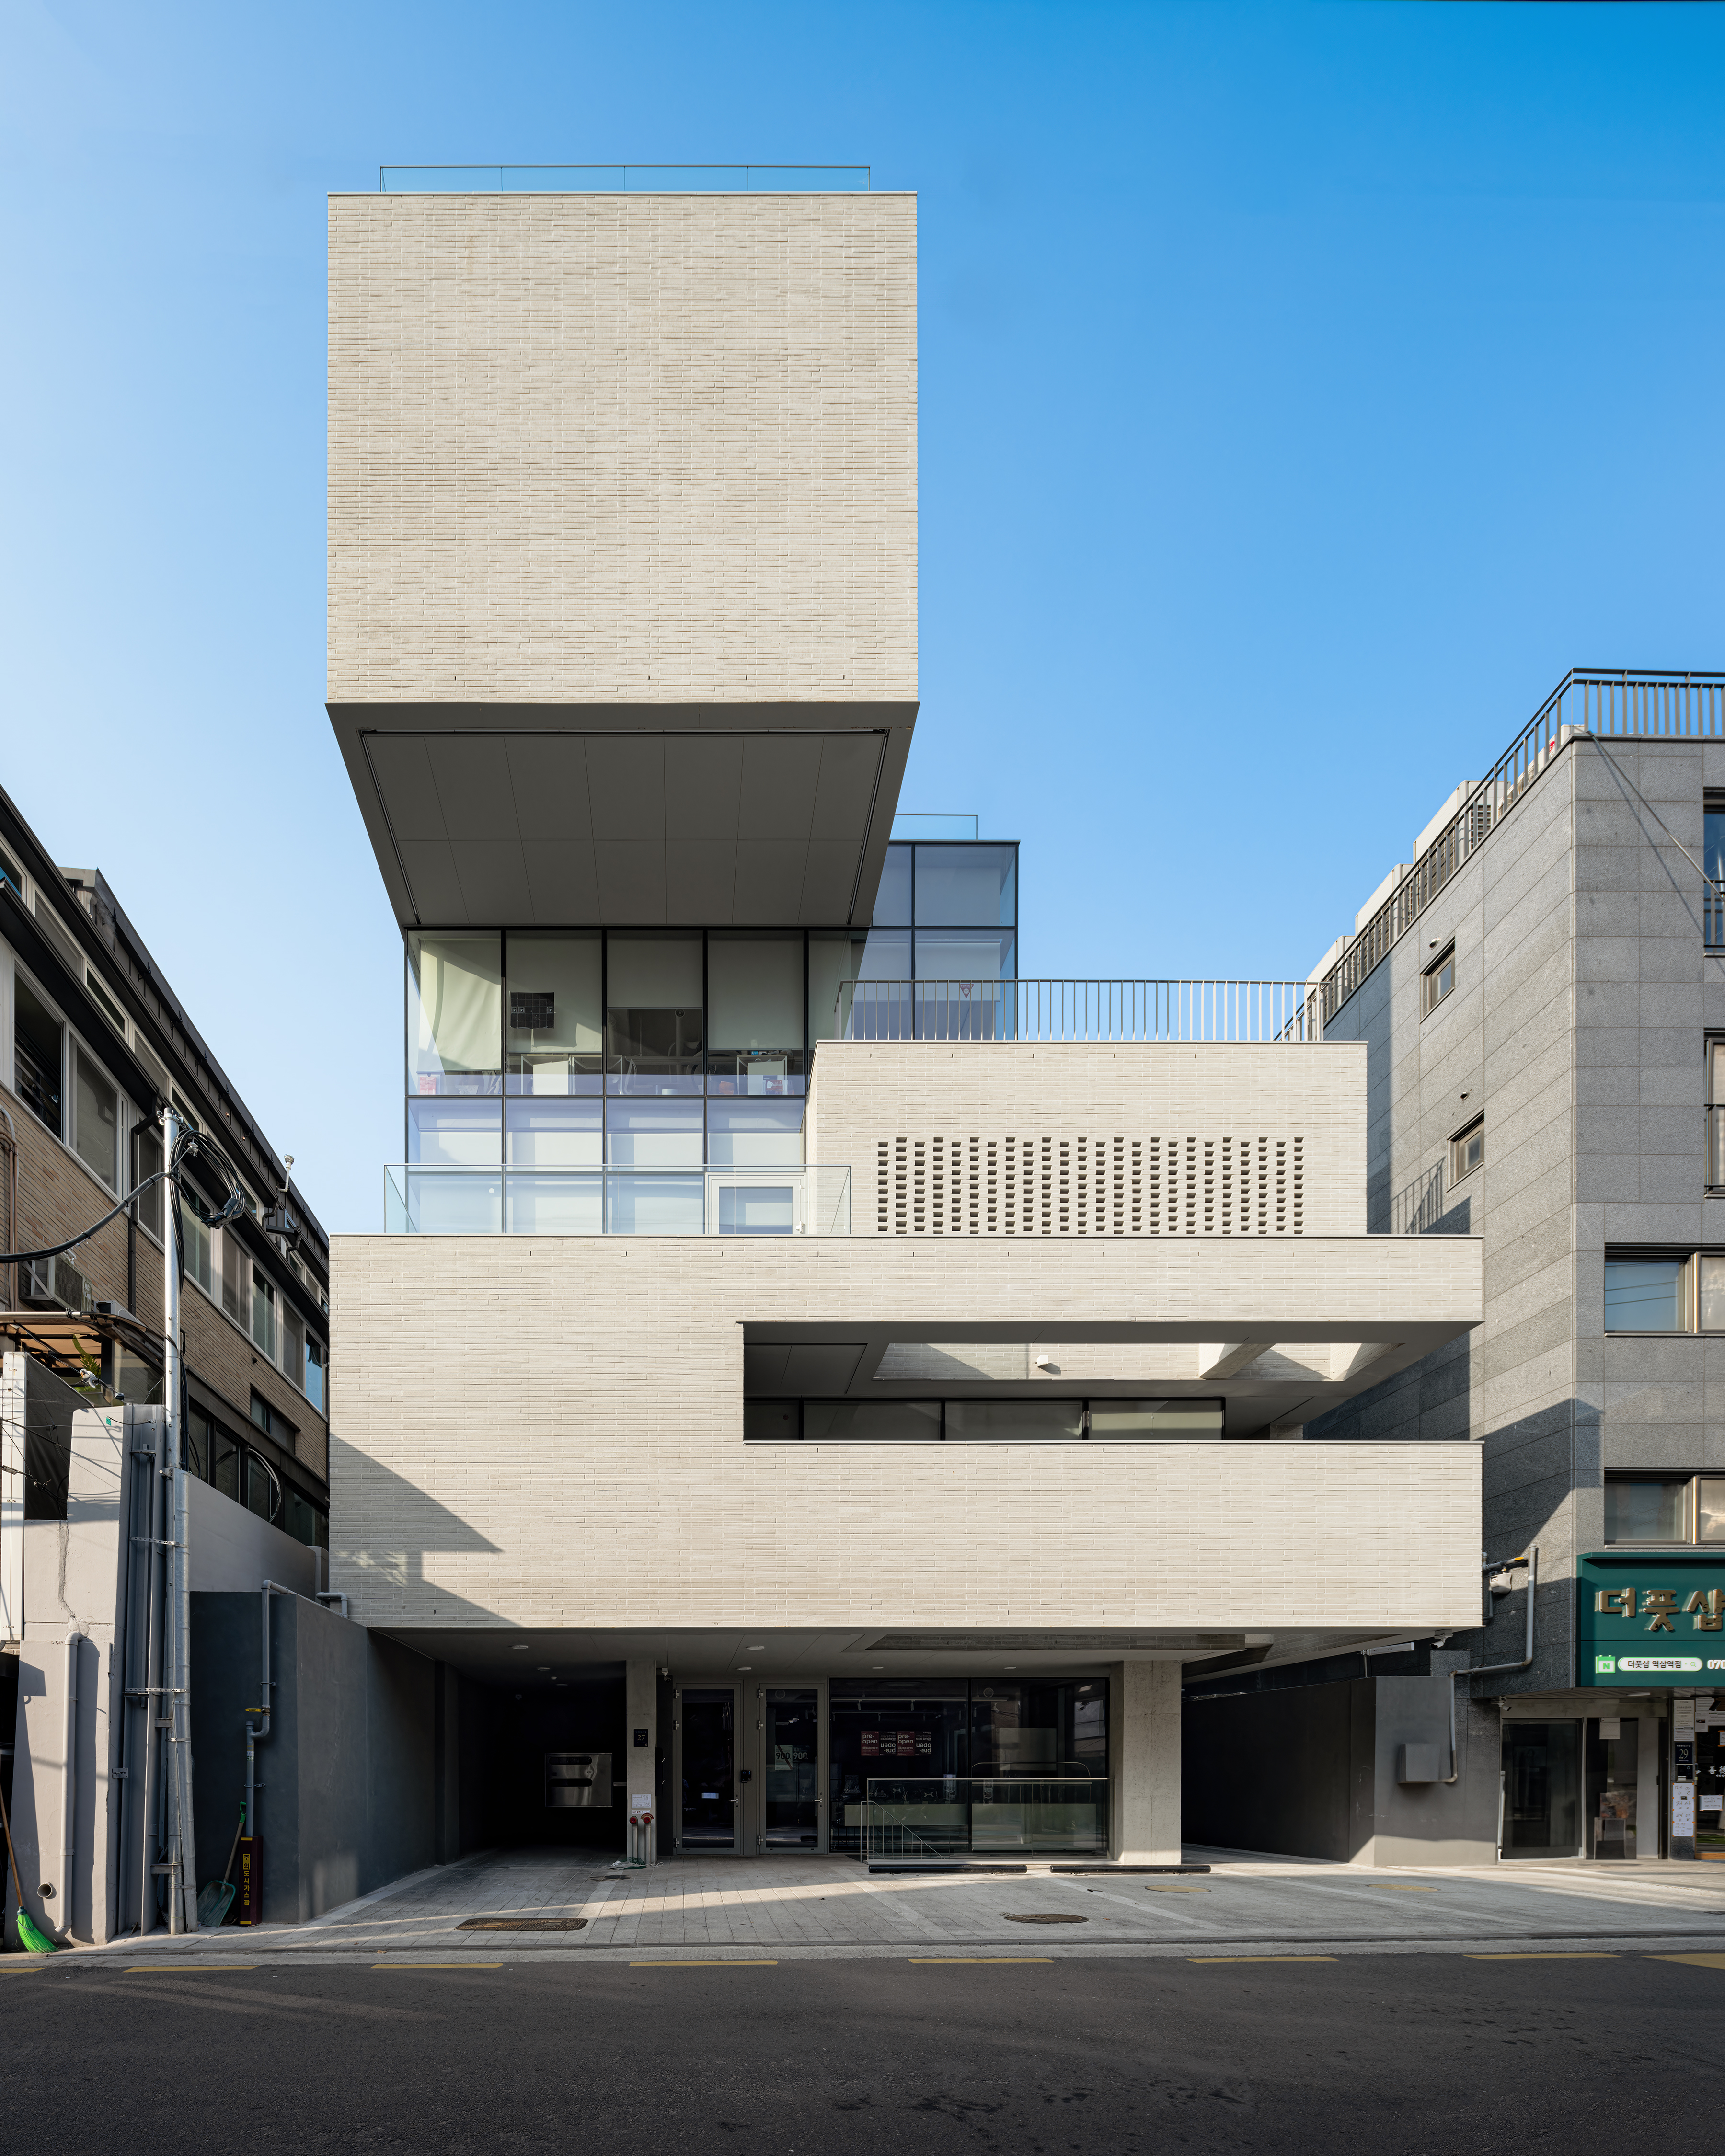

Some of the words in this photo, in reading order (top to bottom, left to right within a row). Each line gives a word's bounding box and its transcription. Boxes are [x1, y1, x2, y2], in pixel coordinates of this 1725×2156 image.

[1627, 1660, 1650, 1668] 더풋샵
[1652, 1660, 1681, 1668] 역삼역점
[1679, 1749, 1688, 1759] 29
[244, 1854, 249, 1869] 주의
